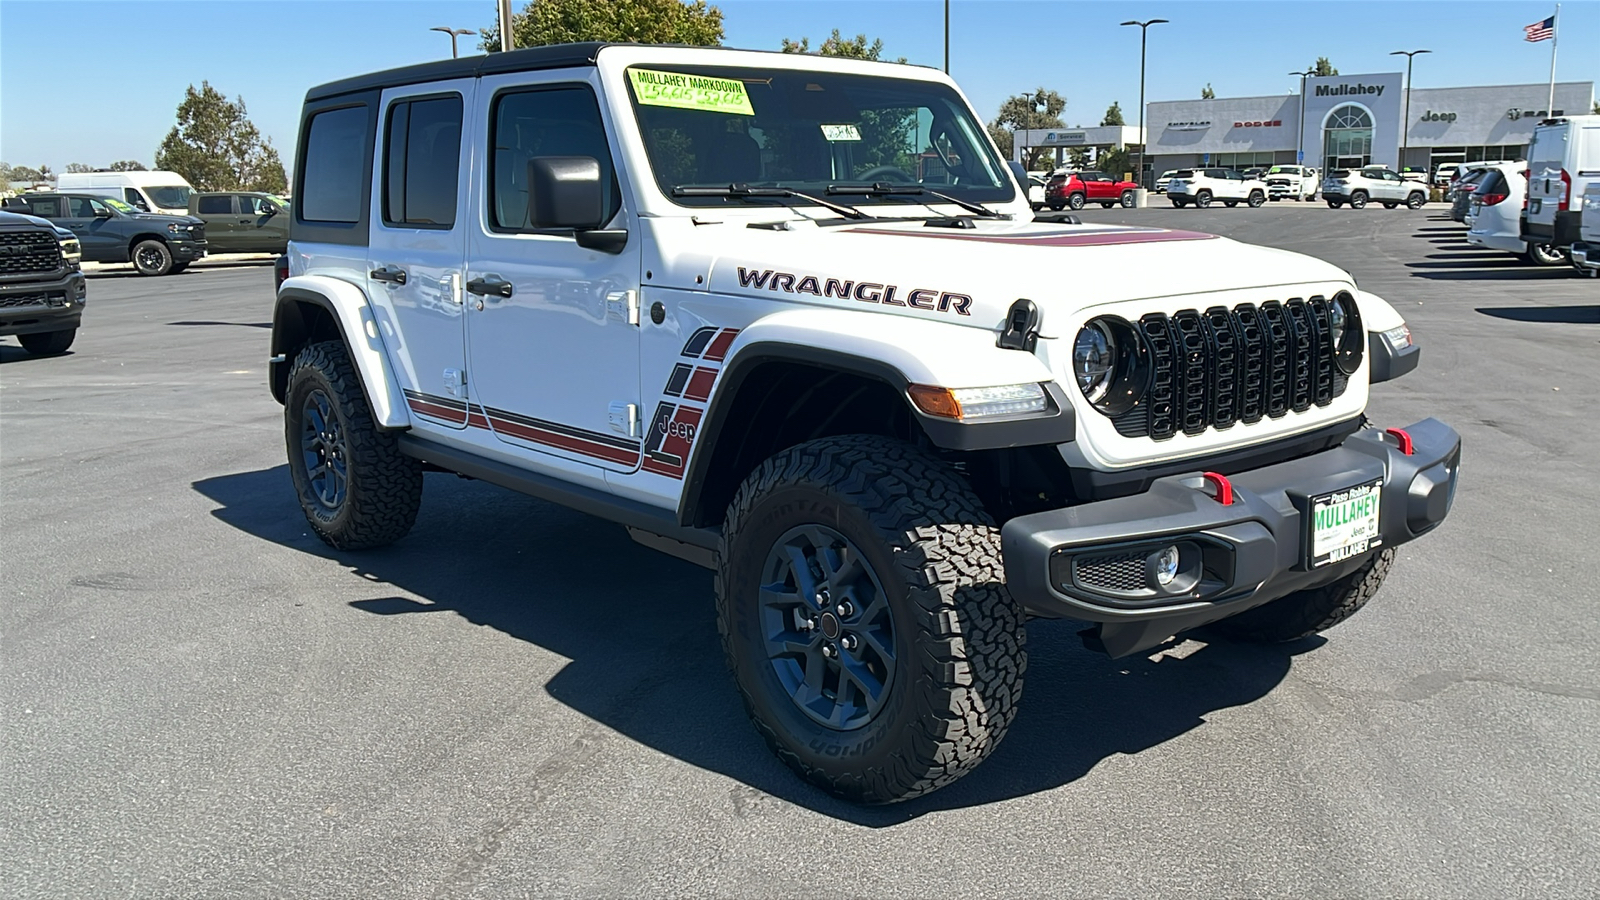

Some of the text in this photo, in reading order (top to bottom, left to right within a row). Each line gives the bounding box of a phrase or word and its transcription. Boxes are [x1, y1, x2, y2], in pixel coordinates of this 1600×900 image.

[637, 71, 743, 93] MULLAHEY MARKDOWN
[1315, 84, 1385, 97] Mullahey
[1421, 110, 1457, 123] Jeep
[737, 266, 973, 316] WRANGLER
[659, 415, 696, 443] Jeep
[1331, 492, 1349, 505] Paso
[1315, 494, 1378, 531] MULLAHEY
[1351, 527, 1365, 538] Jeep
[1330, 539, 1369, 563] MULLAHEY
